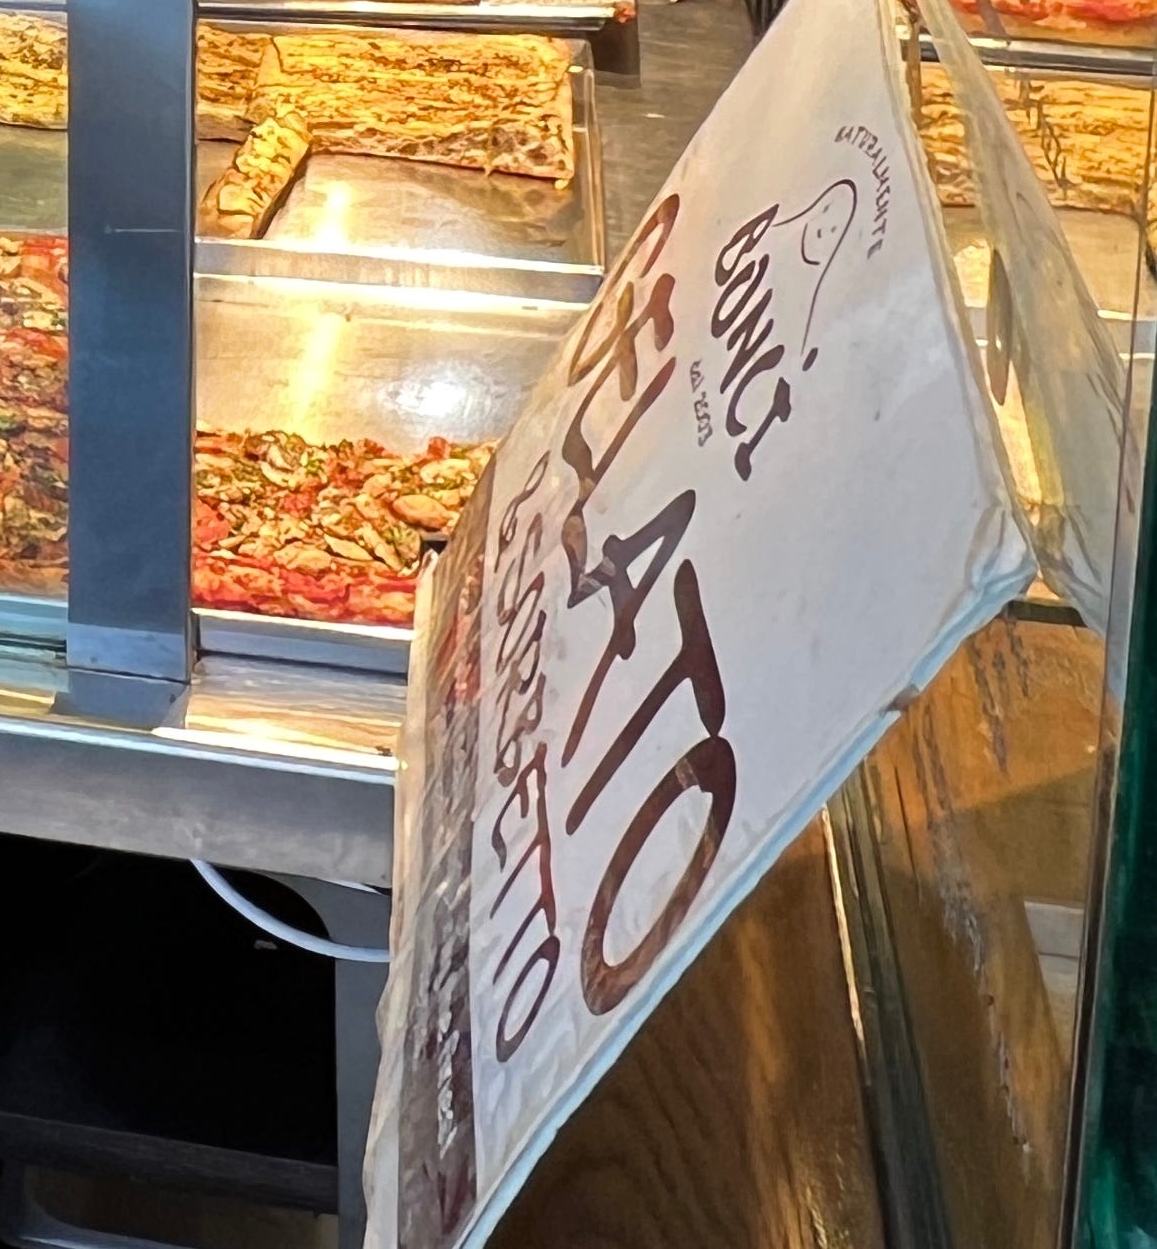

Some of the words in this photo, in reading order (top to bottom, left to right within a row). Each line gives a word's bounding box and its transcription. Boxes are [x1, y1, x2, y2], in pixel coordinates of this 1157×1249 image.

[561, 193, 737, 1016] GELATO
[711, 204, 792, 482] BONCI
[490, 512, 560, 1064] SORBETTO
